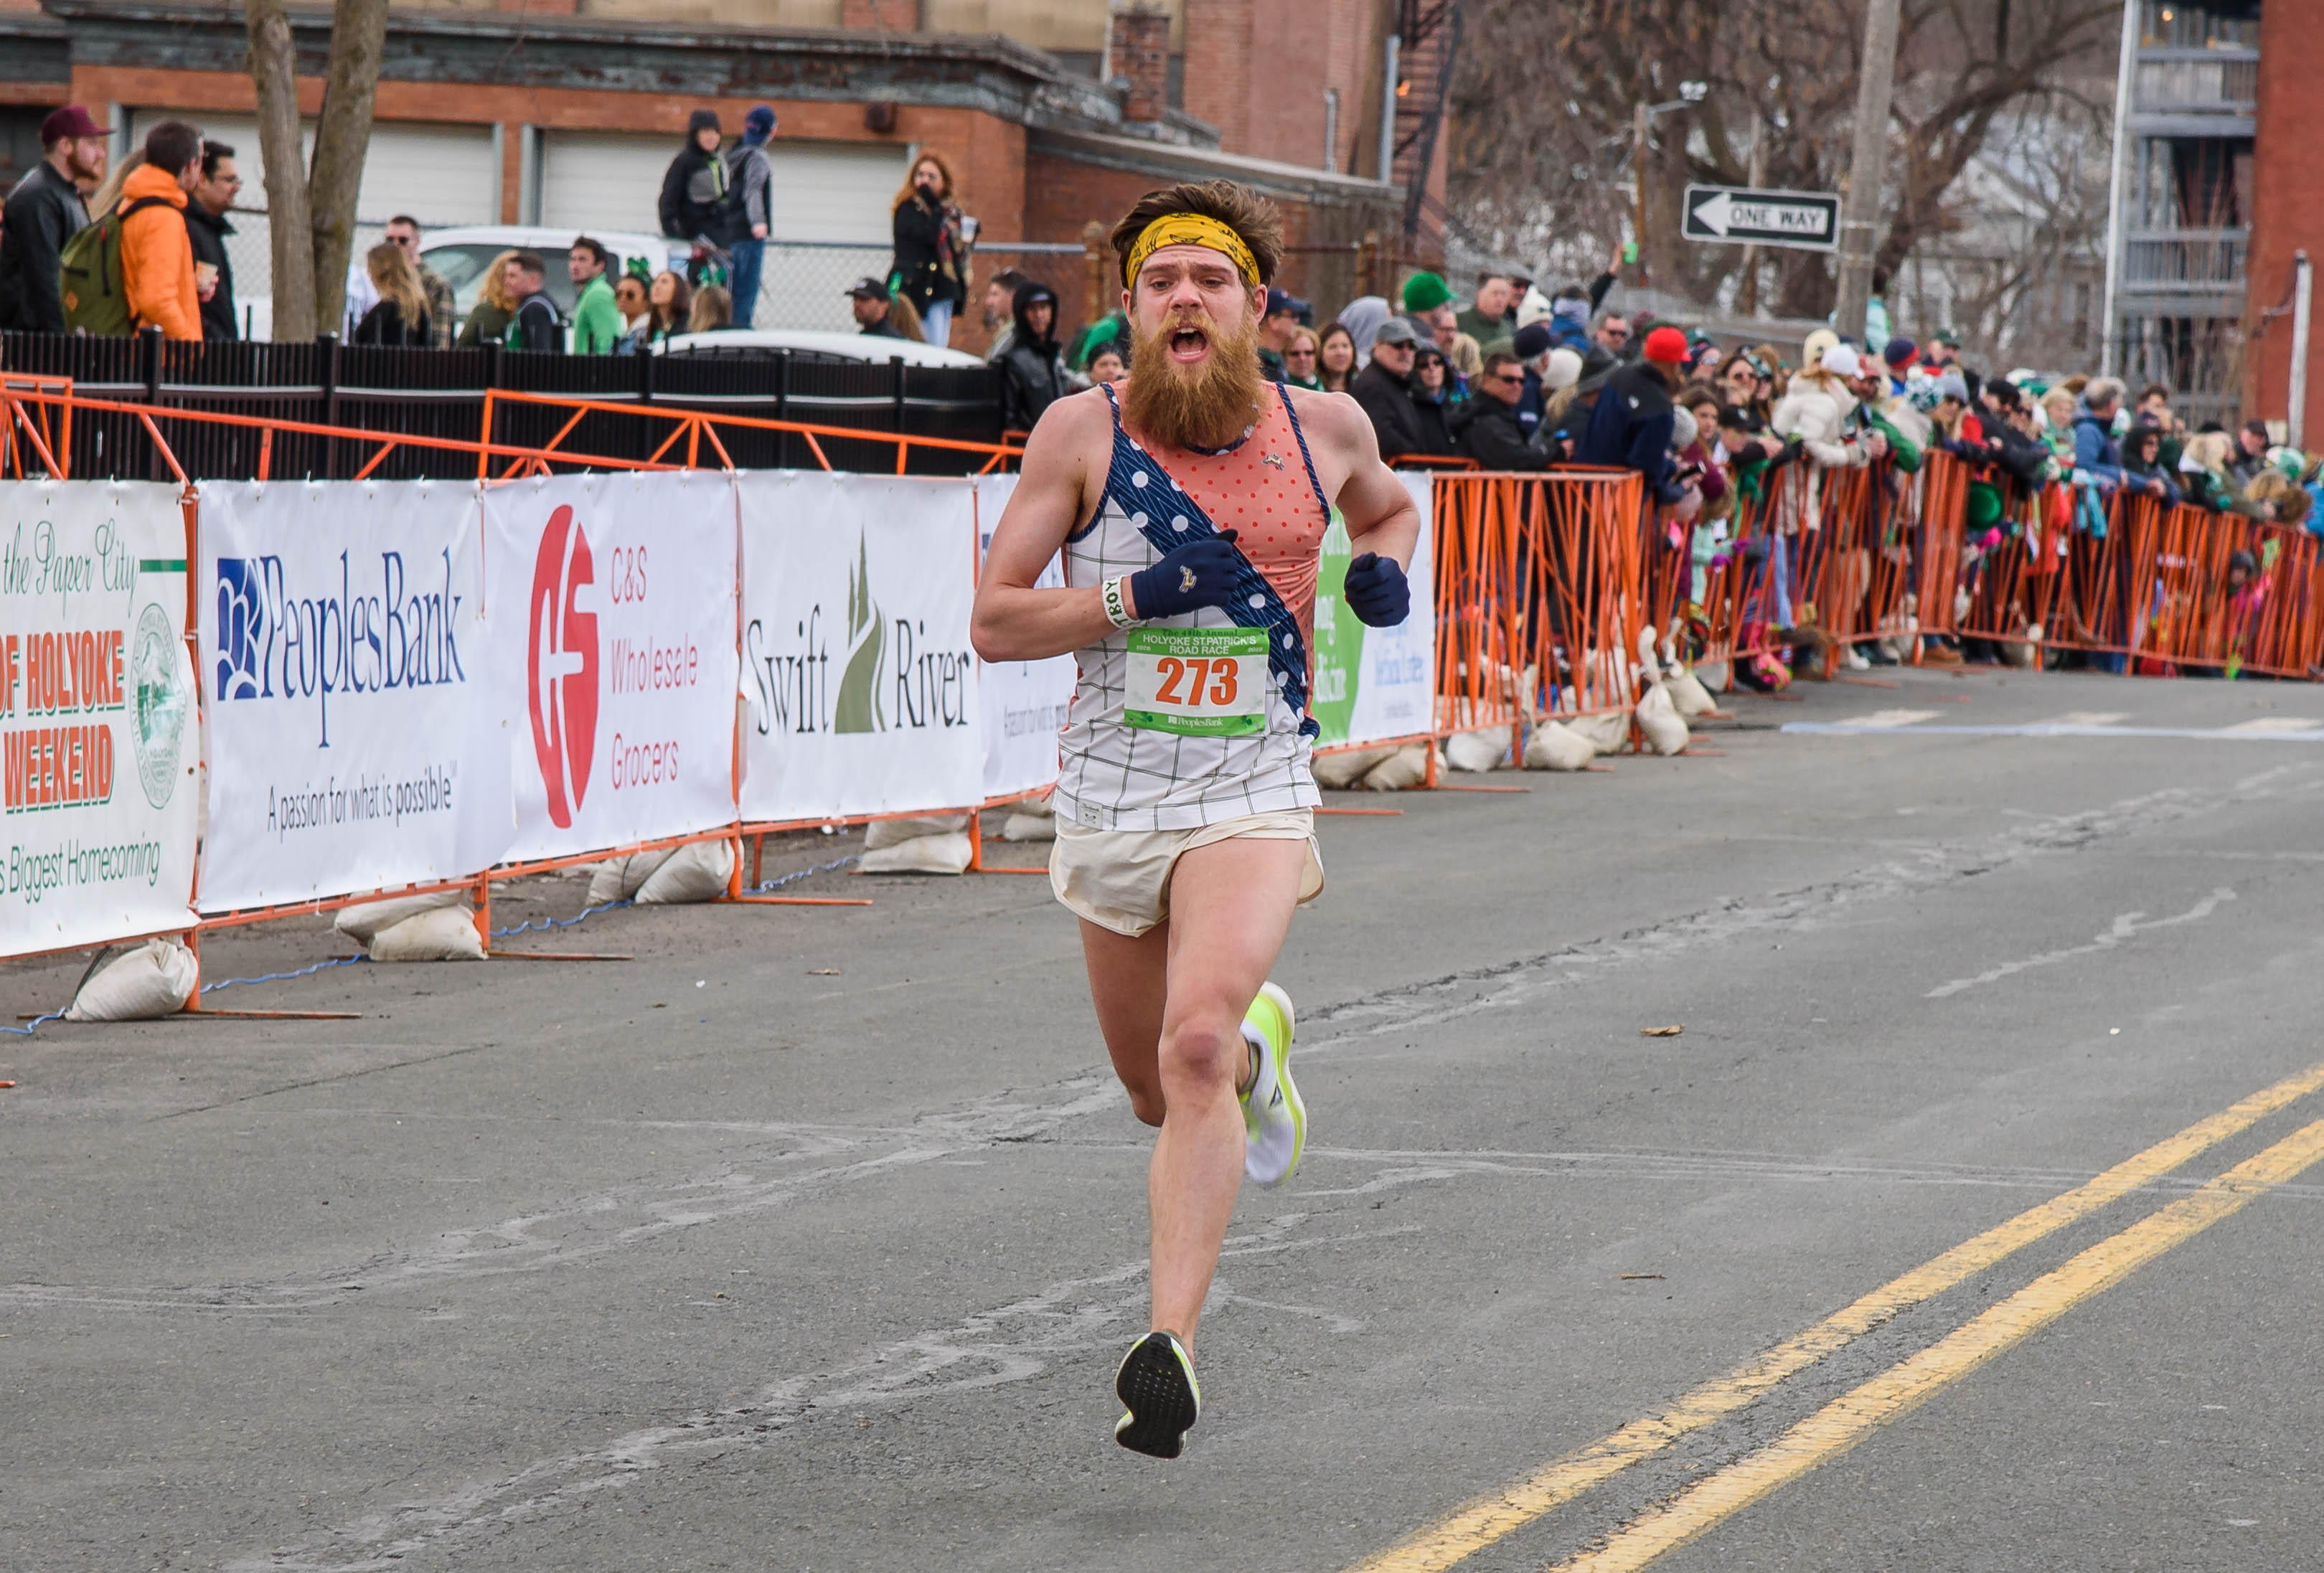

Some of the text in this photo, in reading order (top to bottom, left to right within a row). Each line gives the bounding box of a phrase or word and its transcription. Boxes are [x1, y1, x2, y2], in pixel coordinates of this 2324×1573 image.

[1731, 207, 1821, 227] ONE WAY
[4, 517, 138, 620] the Paper City
[611, 545, 647, 604] C&S
[260, 544, 466, 749] PeoplesBank
[611, 632, 698, 694] Wholesale
[748, 603, 969, 737] Swift River
[1142, 634, 1190, 646] HOLYOKE
[1169, 646, 1230, 655] ROAD RACE
[27, 630, 125, 717] HOLYOKE
[1155, 657, 1239, 707] 273
[1177, 718, 1223, 728] PeoplesBank
[4, 724, 115, 815] WEEKEND
[611, 732, 679, 790] Grocers
[268, 785, 277, 832] A
[281, 781, 326, 844] passion
[329, 775, 347, 825] for
[349, 773, 380, 821] what
[382, 773, 393, 817] is
[395, 763, 452, 828] possible
[10, 844, 64, 904] Biggest
[67, 830, 161, 887] Homecoming
